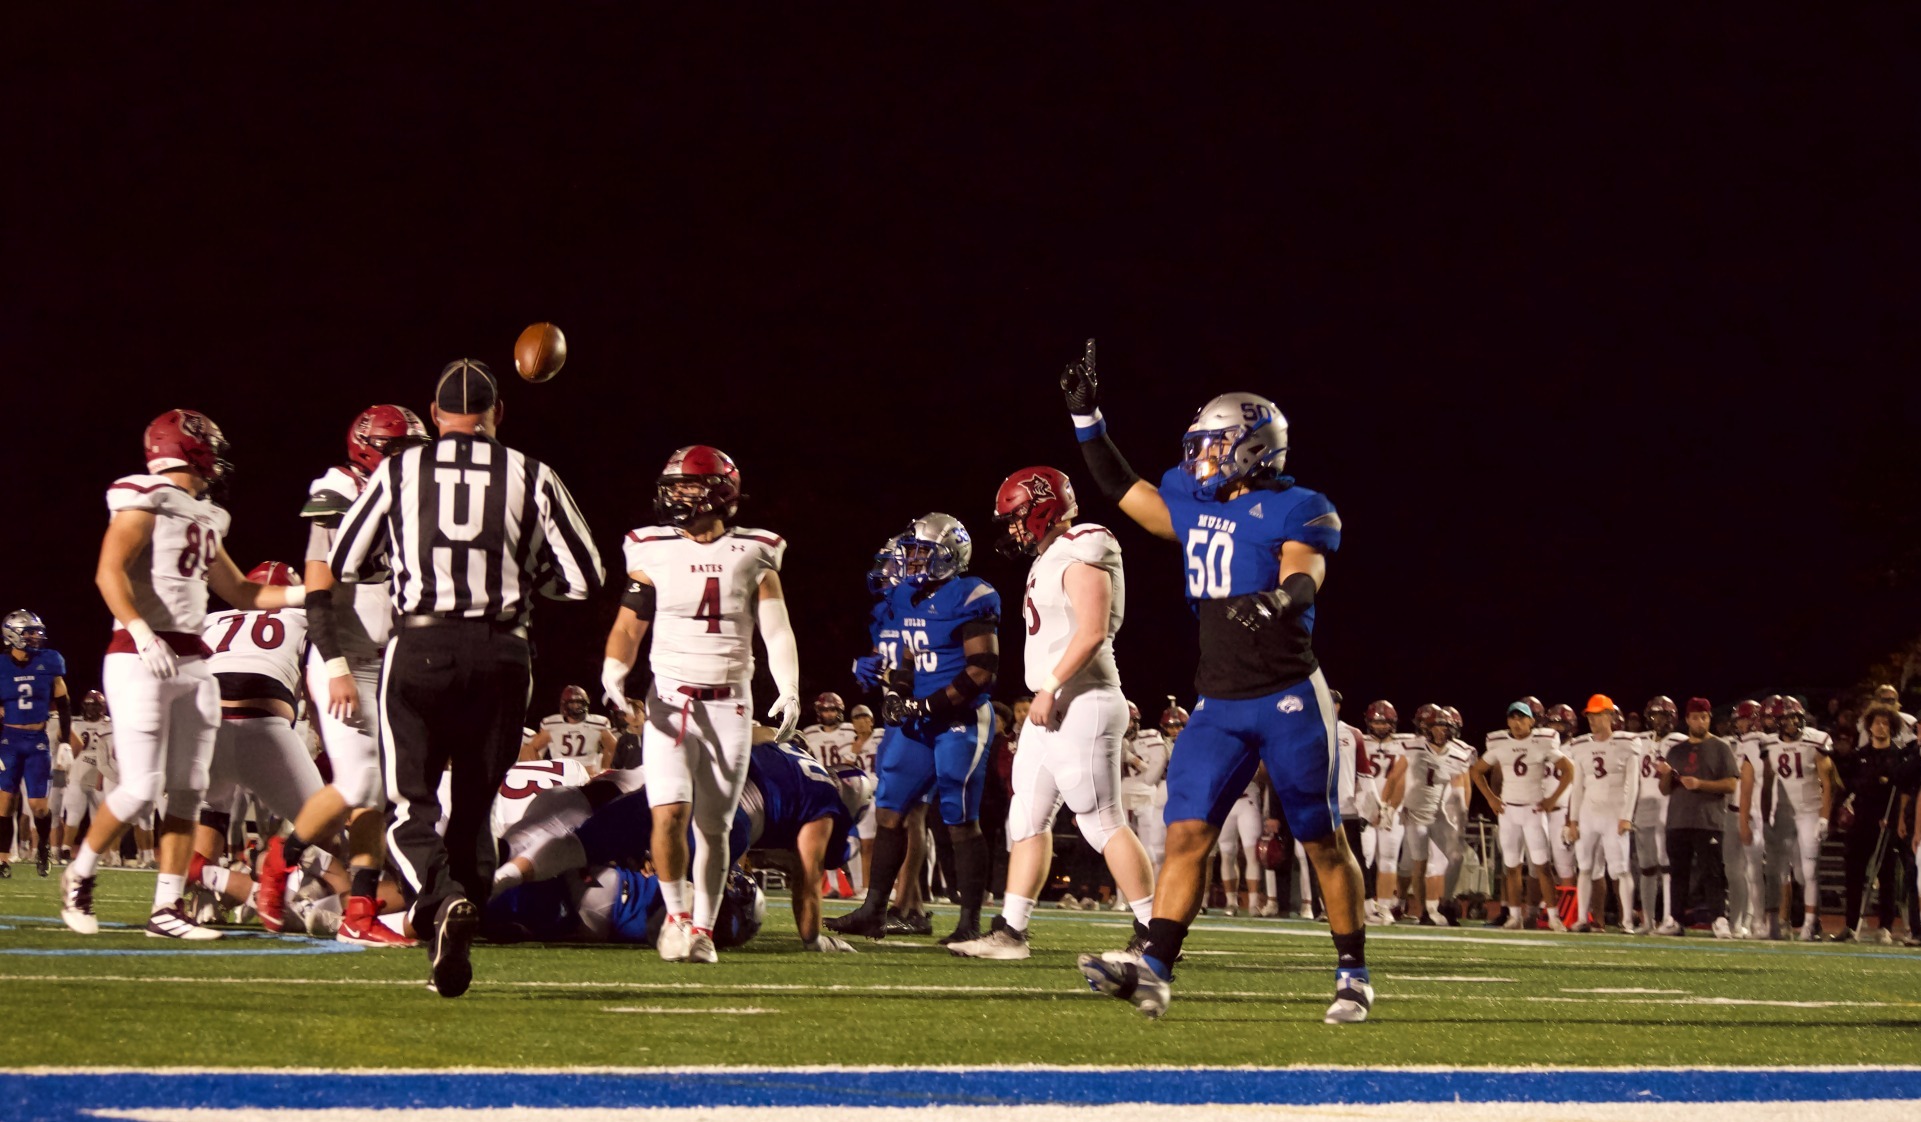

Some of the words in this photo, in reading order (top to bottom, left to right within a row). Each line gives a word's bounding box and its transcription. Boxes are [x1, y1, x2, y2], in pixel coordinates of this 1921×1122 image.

[434, 467, 491, 541] U
[1198, 514, 1237, 534] MULES
[690, 564, 723, 573] BATES
[1187, 528, 1234, 599] 50
[694, 577, 723, 634] 4
[214, 608, 286, 653] 76
[17, 683, 33, 710] 2
[560, 734, 588, 757] 52
[820, 745, 841, 767] 18
[1514, 753, 1528, 777] 6
[1592, 756, 1608, 779] 3
[1777, 752, 1804, 779] 81
